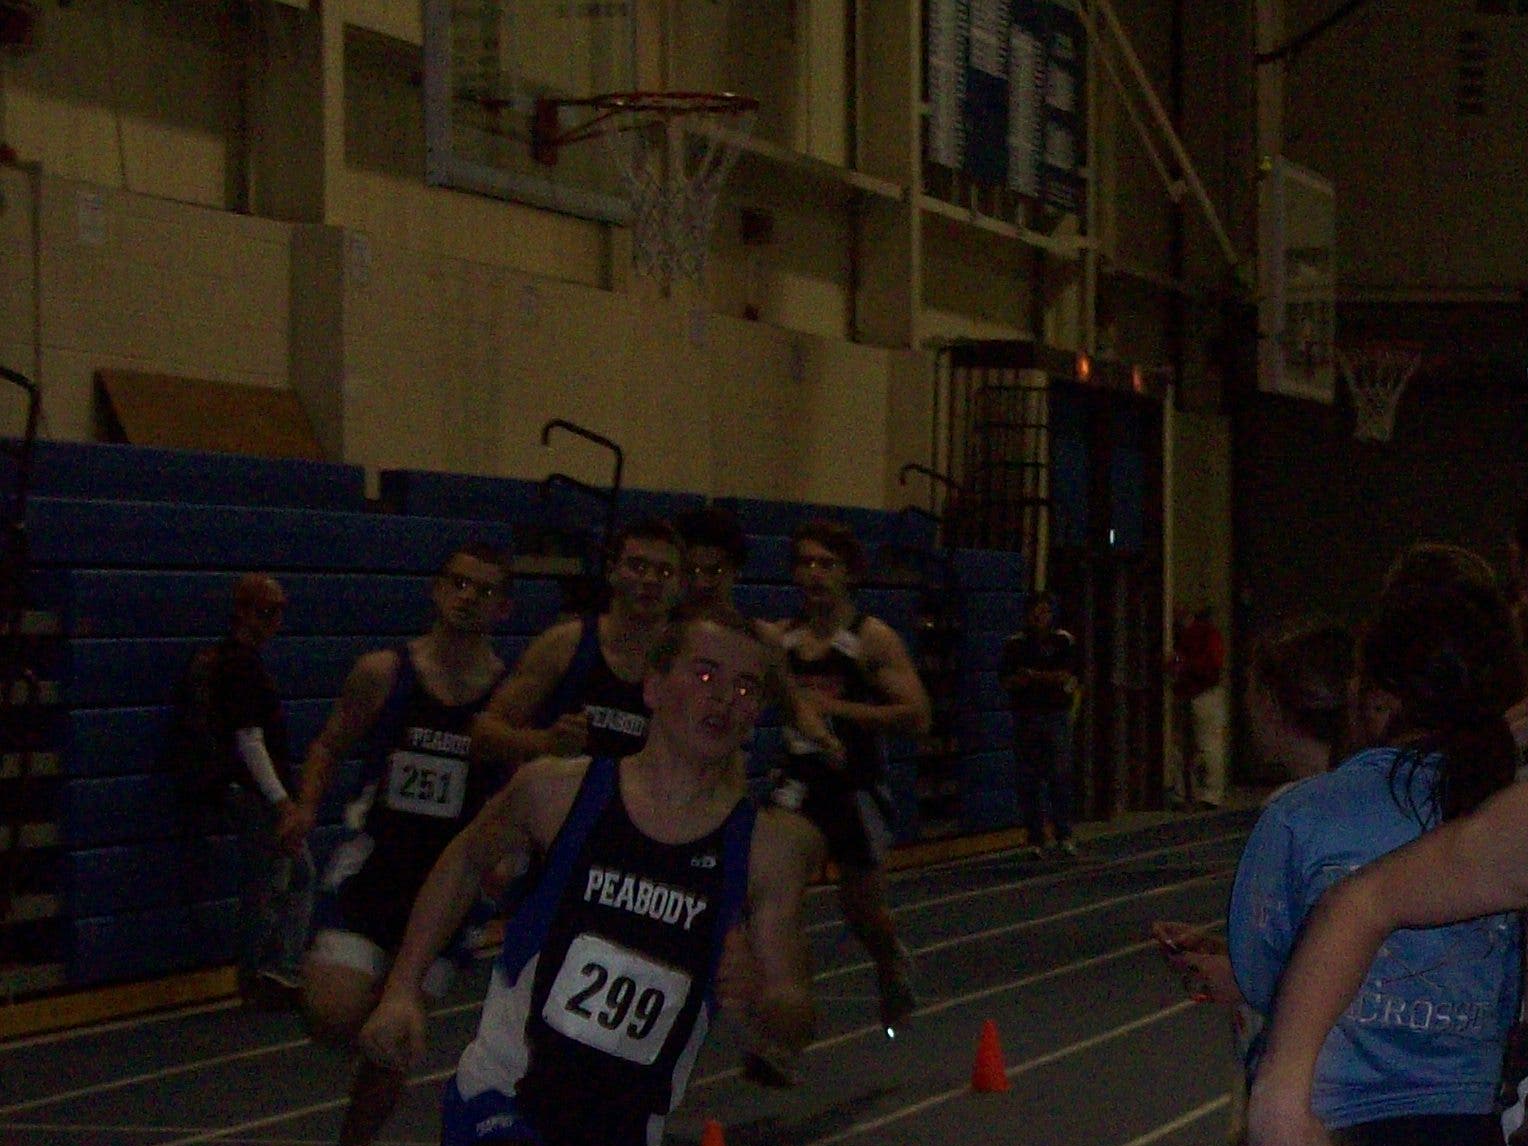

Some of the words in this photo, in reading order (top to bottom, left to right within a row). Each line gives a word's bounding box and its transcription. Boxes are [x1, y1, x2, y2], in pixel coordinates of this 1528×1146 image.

[399, 764, 452, 804] 251
[583, 867, 708, 932] PEABODY
[564, 962, 666, 1041] 299
[1348, 990, 1492, 1032] CROSSE
